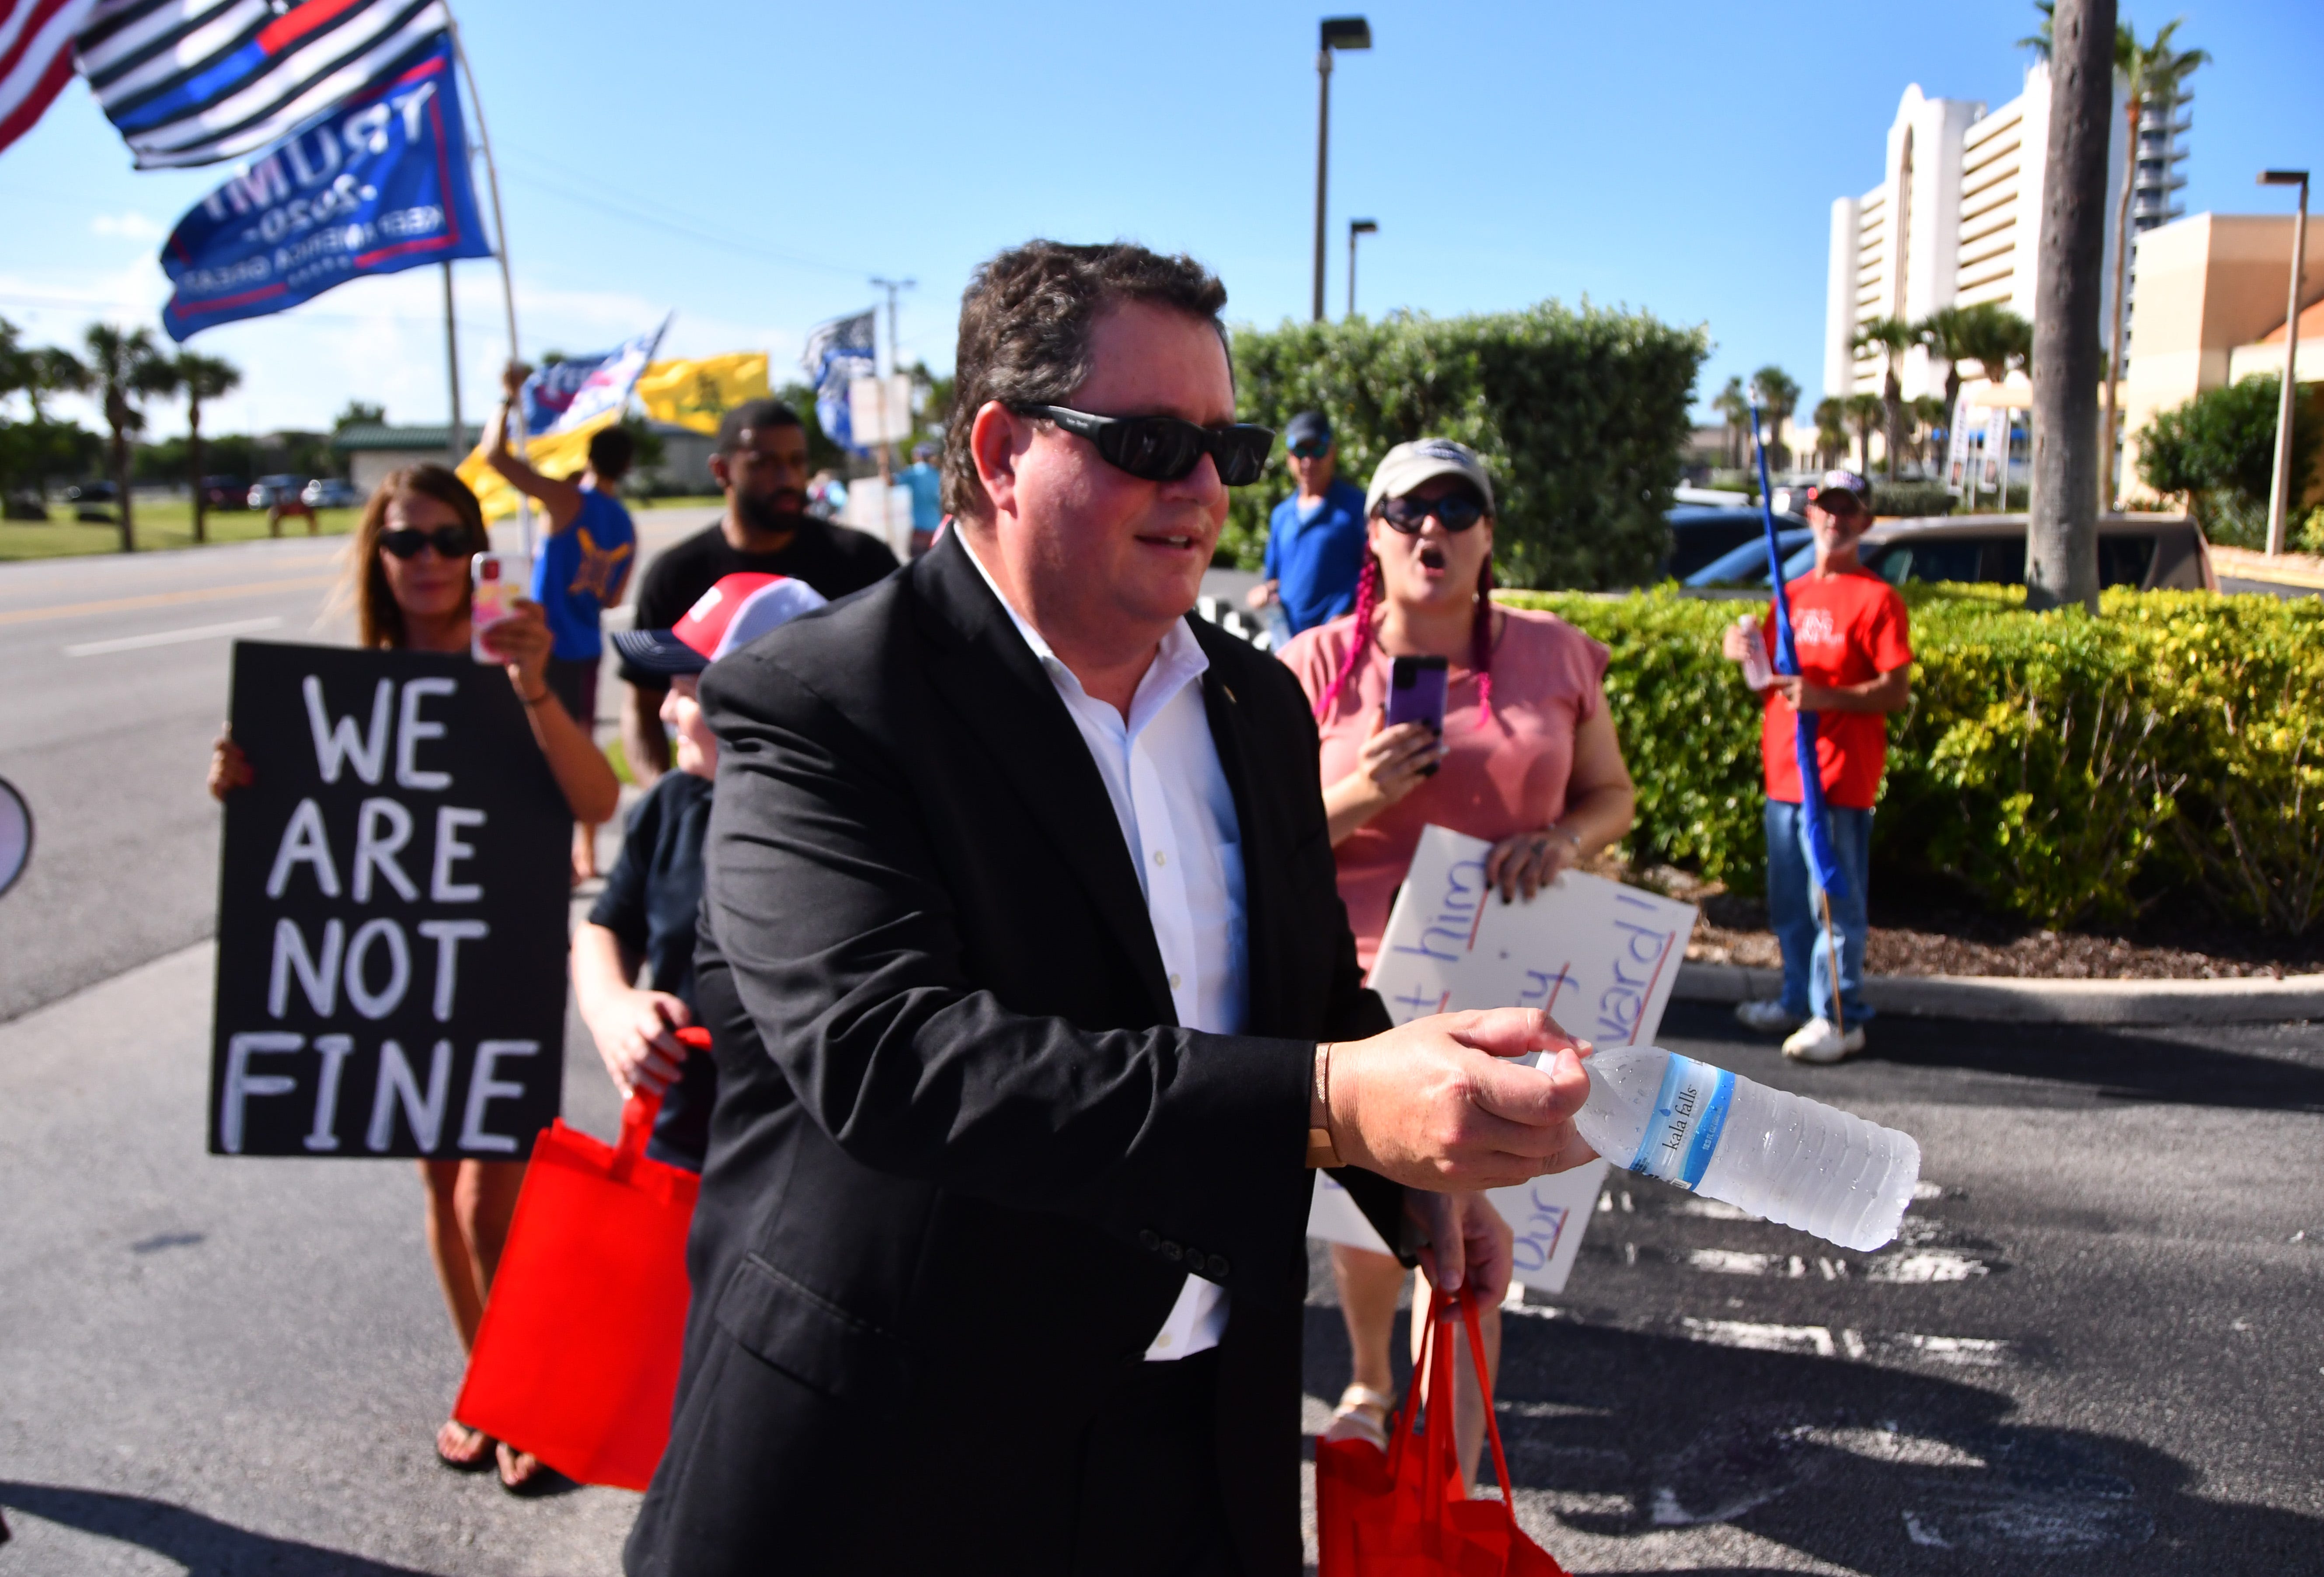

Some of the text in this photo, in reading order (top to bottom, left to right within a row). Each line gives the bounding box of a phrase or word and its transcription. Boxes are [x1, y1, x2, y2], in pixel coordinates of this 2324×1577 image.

[302, 673, 459, 790] WE
[265, 796, 488, 904] ARE
[267, 917, 491, 1022] NOT
[220, 1031, 542, 1154] FINE
[1662, 1120, 1687, 1151] kala
